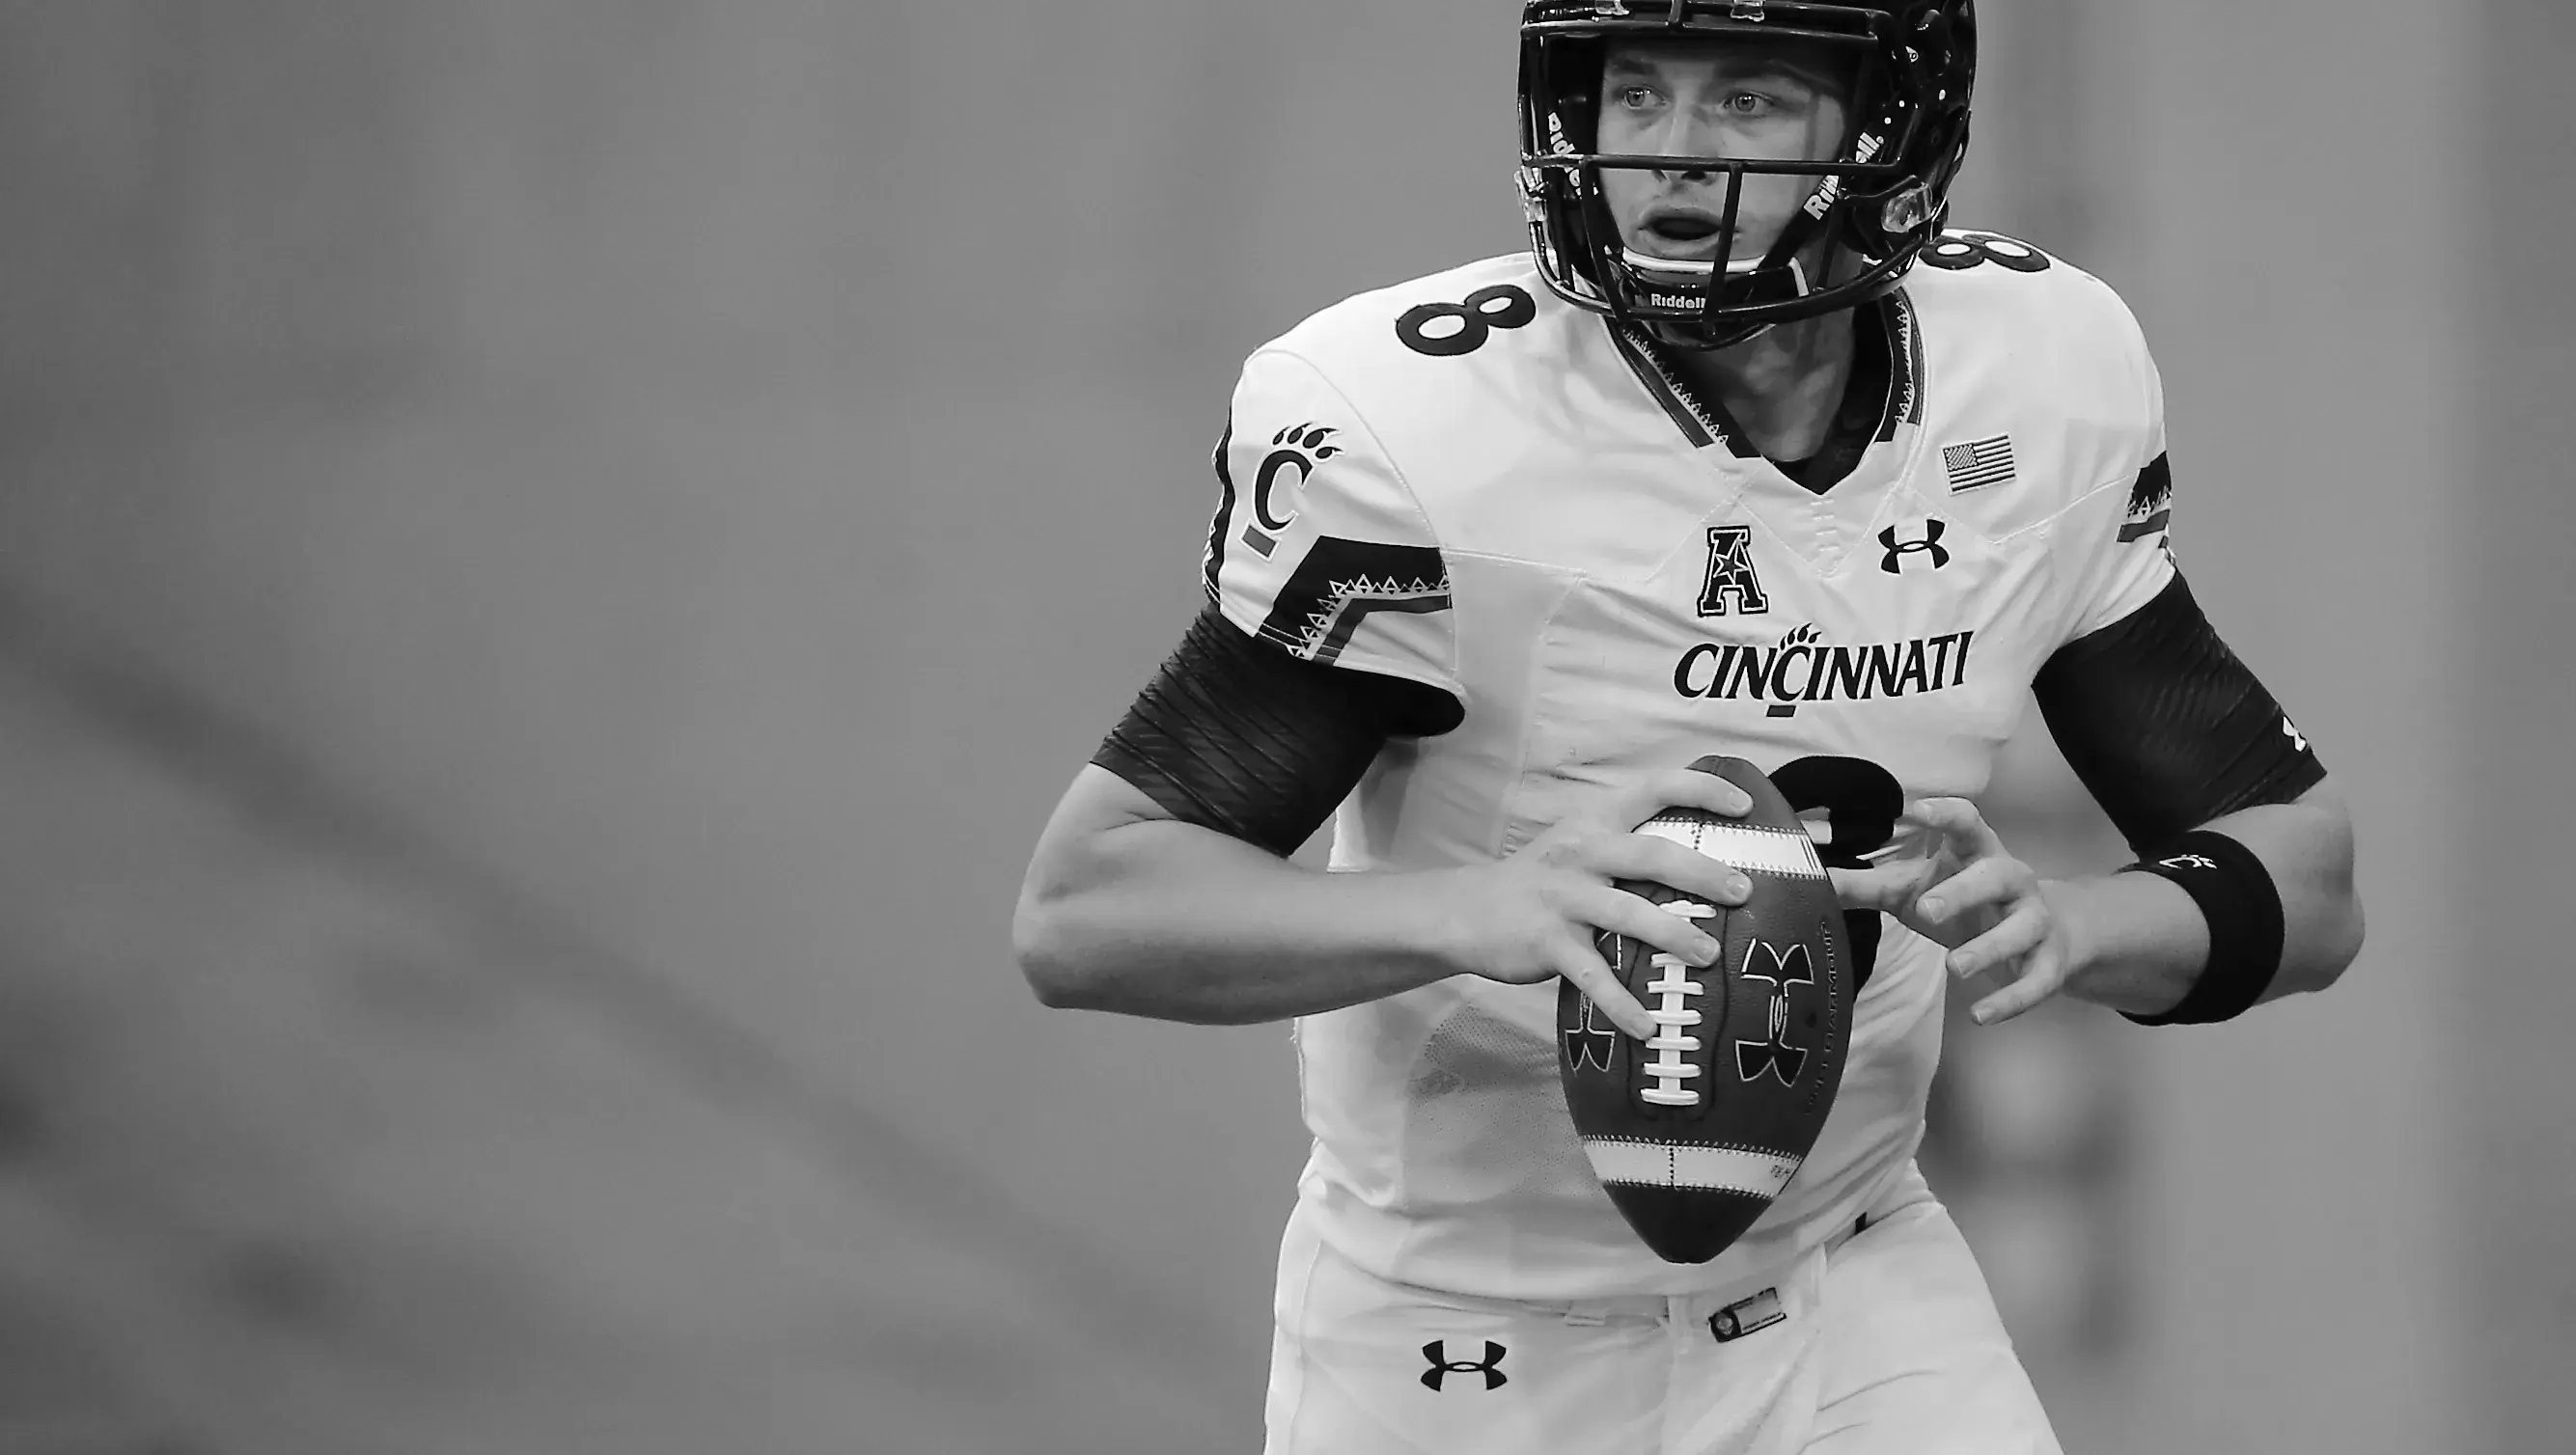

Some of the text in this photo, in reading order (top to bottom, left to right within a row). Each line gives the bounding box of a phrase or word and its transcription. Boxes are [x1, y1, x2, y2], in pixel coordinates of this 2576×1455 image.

[1918, 234, 2050, 272] 8
[1396, 284, 1536, 356] 8
[1650, 292, 1706, 309] Riddell
[1255, 450, 1315, 531] C
[1697, 526, 1768, 618] A
[1674, 627, 1975, 702] CINCINNATI
